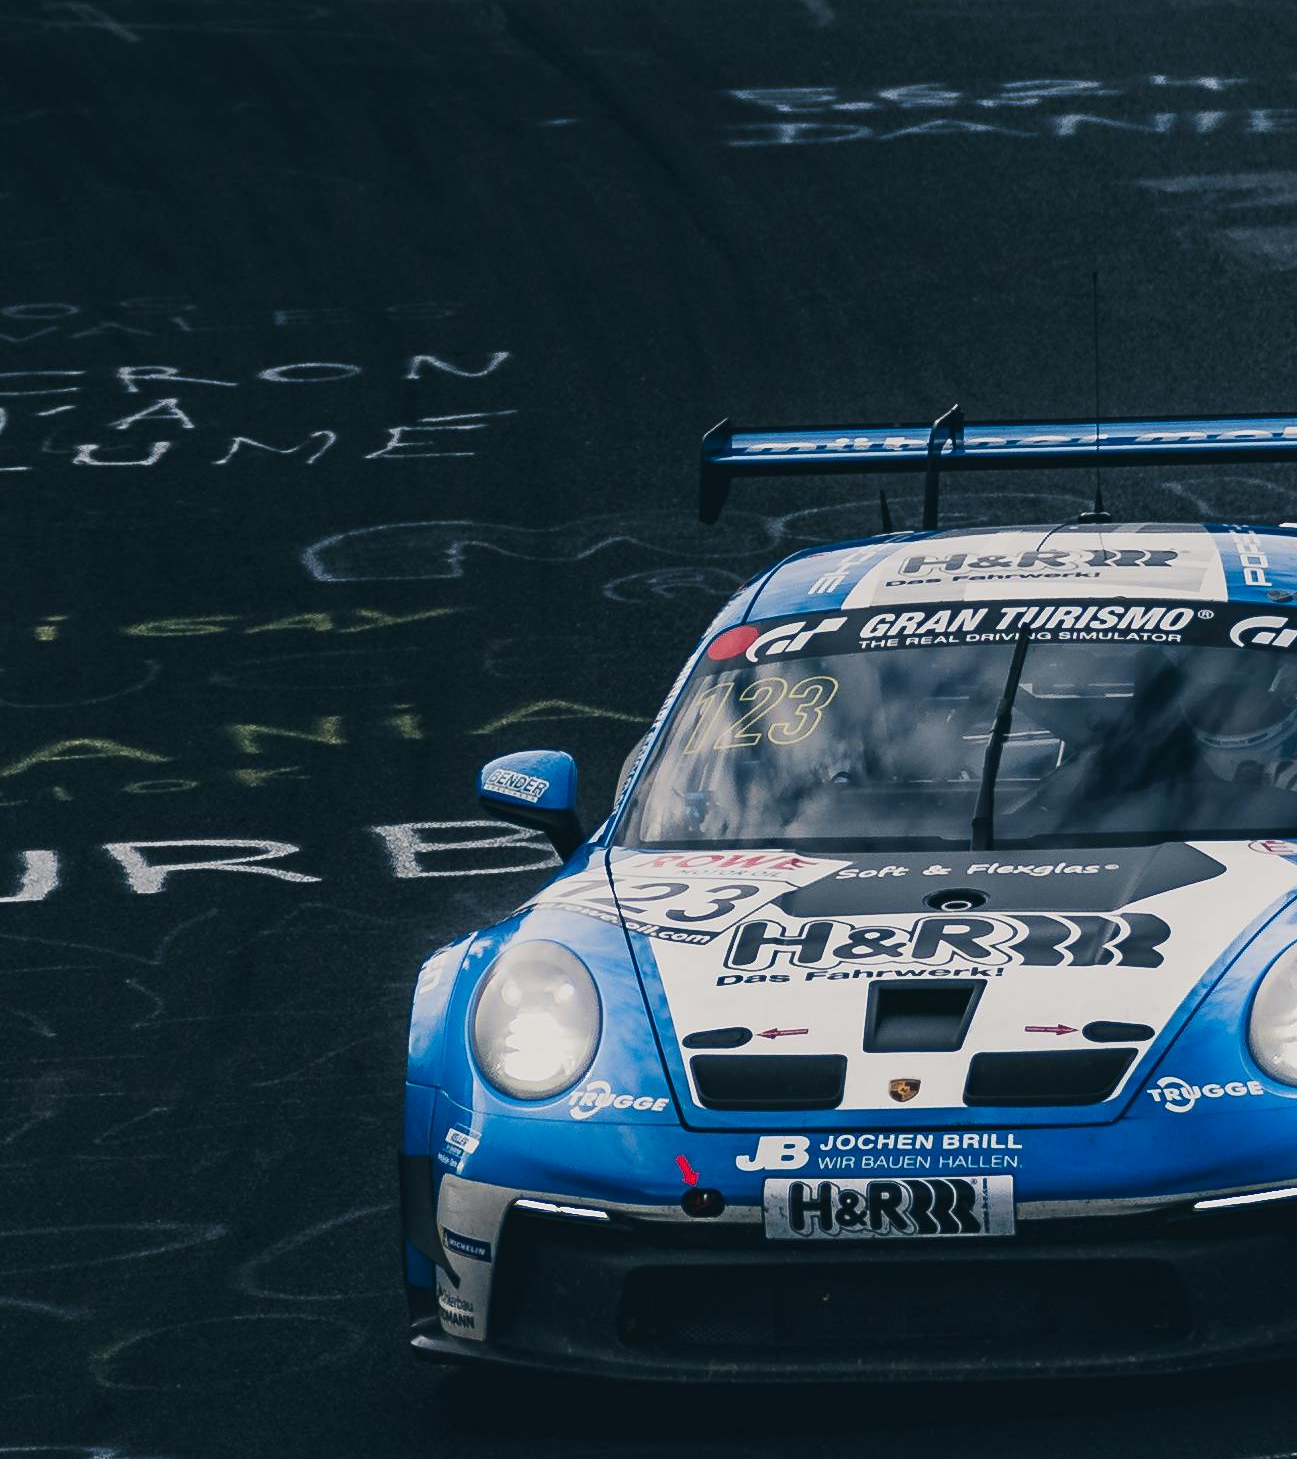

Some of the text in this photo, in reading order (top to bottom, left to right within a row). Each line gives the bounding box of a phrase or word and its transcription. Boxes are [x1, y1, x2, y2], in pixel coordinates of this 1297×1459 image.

[884, 577, 942, 588] Das
[858, 610, 989, 641] GRAN
[858, 636, 899, 649] THE
[905, 633, 960, 647] REAL
[1058, 630, 1183, 643] SIMULATOR
[683, 675, 840, 755] 123
[486, 770, 550, 798] BENDER
[836, 864, 908, 881] Soft
[922, 863, 952, 877] &
[557, 882, 760, 923] 123
[724, 916, 1049, 970] H&R
[715, 965, 1006, 987] Das Fahrwerk!
[1146, 1077, 1266, 1112] TRUGGE
[735, 1135, 811, 1171] JB
[819, 1132, 1024, 1151] JOCHEN BRILL
[818, 1155, 855, 1170] WIR
[861, 1155, 931, 1169] BAUEN
[787, 1180, 939, 1237] H&R
[447, 1237, 486, 1258] MICHELIN
